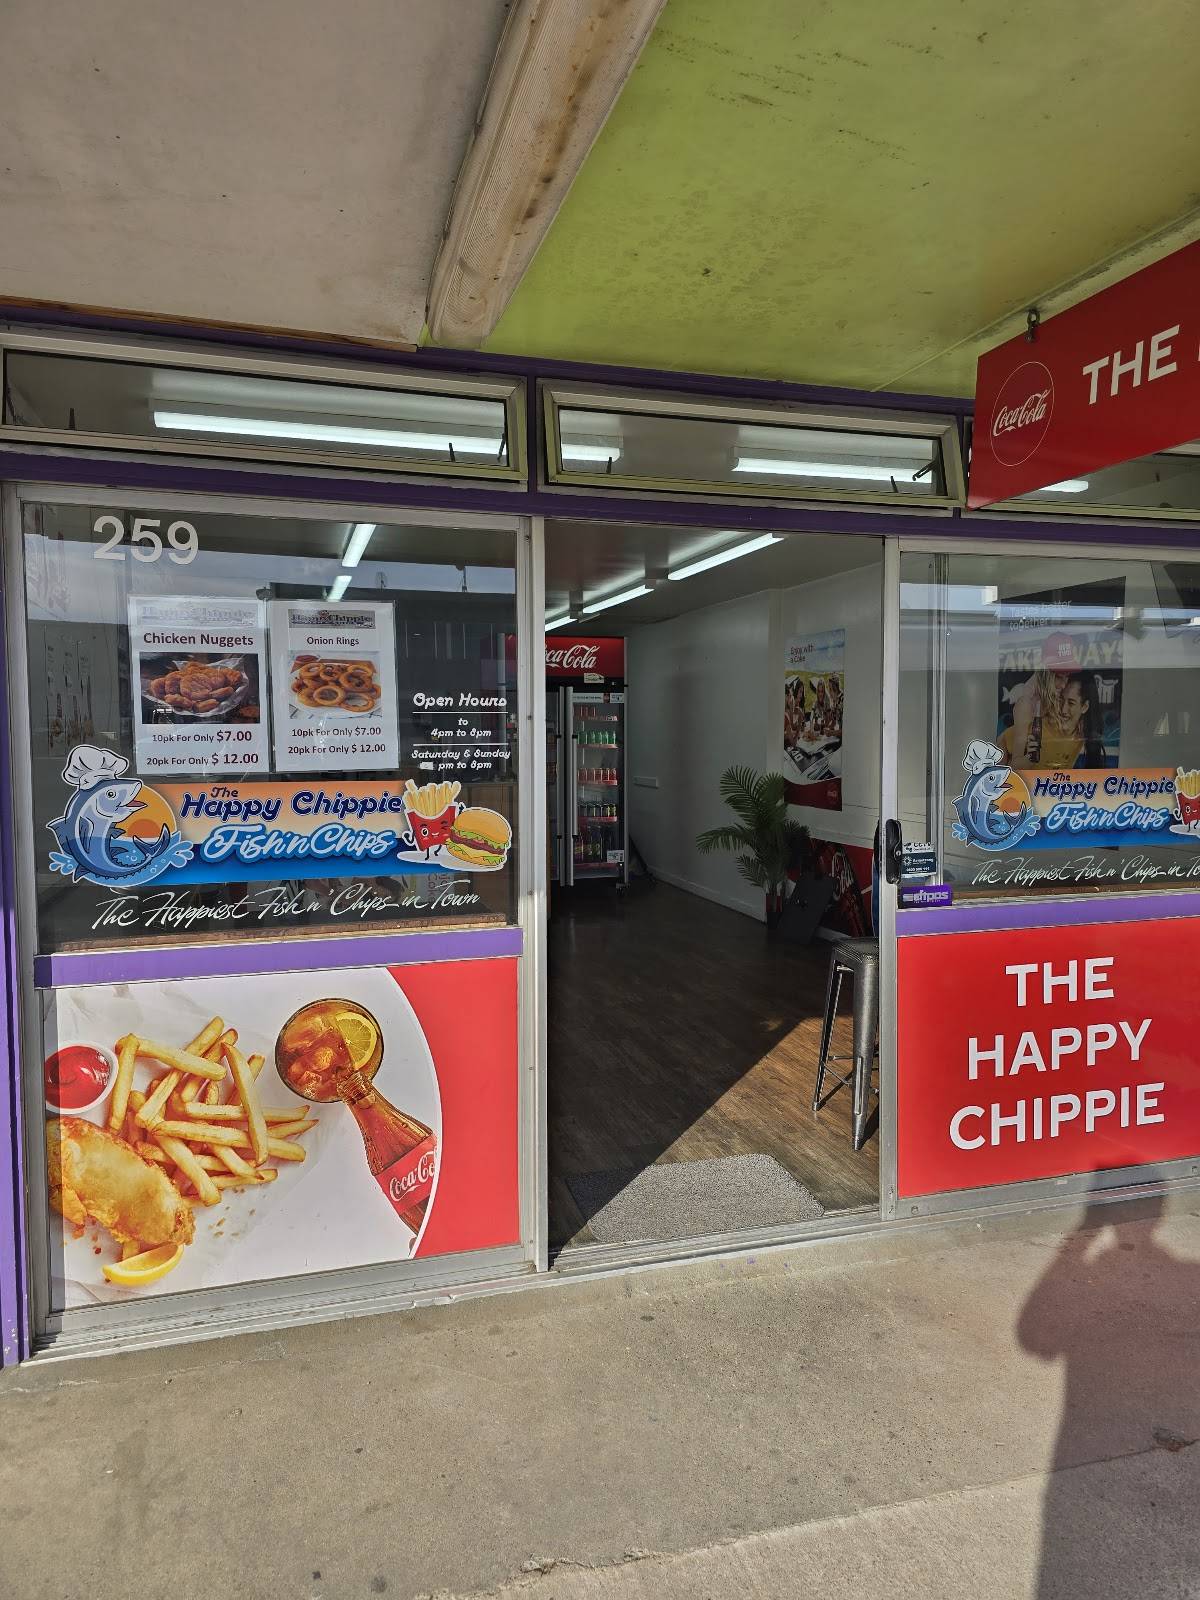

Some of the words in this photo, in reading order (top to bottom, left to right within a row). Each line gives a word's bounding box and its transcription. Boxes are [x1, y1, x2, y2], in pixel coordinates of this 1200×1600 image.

[1082, 325, 1180, 405] THE
[993, 389, 1051, 436] Coca-Cola
[93, 515, 199, 565] 259
[143, 632, 196, 645] Chicken
[200, 633, 254, 648] Nuggets
[306, 636, 334, 645] Onion
[336, 636, 360, 647] Rings
[413, 692, 454, 710] Open
[458, 692, 507, 707] Hours
[457, 717, 469, 726] to
[152, 734, 174, 744] 10pk
[176, 734, 192, 743] For
[193, 734, 214, 744] Only
[216, 729, 253, 743] $7.00
[291, 728, 314, 738] 10pk
[315, 728, 330, 736] For
[332, 728, 353, 738] Only
[354, 726, 382, 737] $7.00
[430, 728, 454, 739] 4pm
[456, 728, 467, 737] to
[469, 727, 492, 739] 8pm
[288, 746, 310, 755] 20pk
[312, 746, 326, 754] For
[328, 744, 349, 755] Only
[351, 743, 357, 754] $
[360, 743, 386, 753] 12.00
[411, 749, 461, 760] Saturday
[463, 749, 471, 758] &
[473, 748, 511, 760] Sunday
[146, 757, 169, 767] 20pk
[171, 757, 186, 765] For
[188, 756, 209, 766] Only
[211, 752, 219, 766] $
[223, 753, 259, 765] 12.00
[456, 761, 467, 769] to
[470, 760, 492, 770] 8pm
[1052, 772, 1071, 782] The
[210, 786, 239, 799] The
[1033, 776, 1097, 800] Happy
[1104, 776, 1176, 799] Chippie
[180, 792, 283, 823] Happy
[291, 789, 402, 820] Chippie
[971, 859, 1002, 885] The
[1004, 857, 1075, 887] Happiest
[1074, 855, 1106, 881] Fish
[1167, 861, 1186, 877] in
[1186, 856, 1200, 878] To
[91, 895, 140, 930] The
[142, 890, 256, 929] Happiest
[254, 886, 307, 920] Fish
[401, 890, 428, 909] in
[431, 879, 481, 910] Town
[1005, 956, 1115, 1007] THE
[968, 1018, 1153, 1081] HAPPY
[949, 1082, 1165, 1150] CHIPPIE
